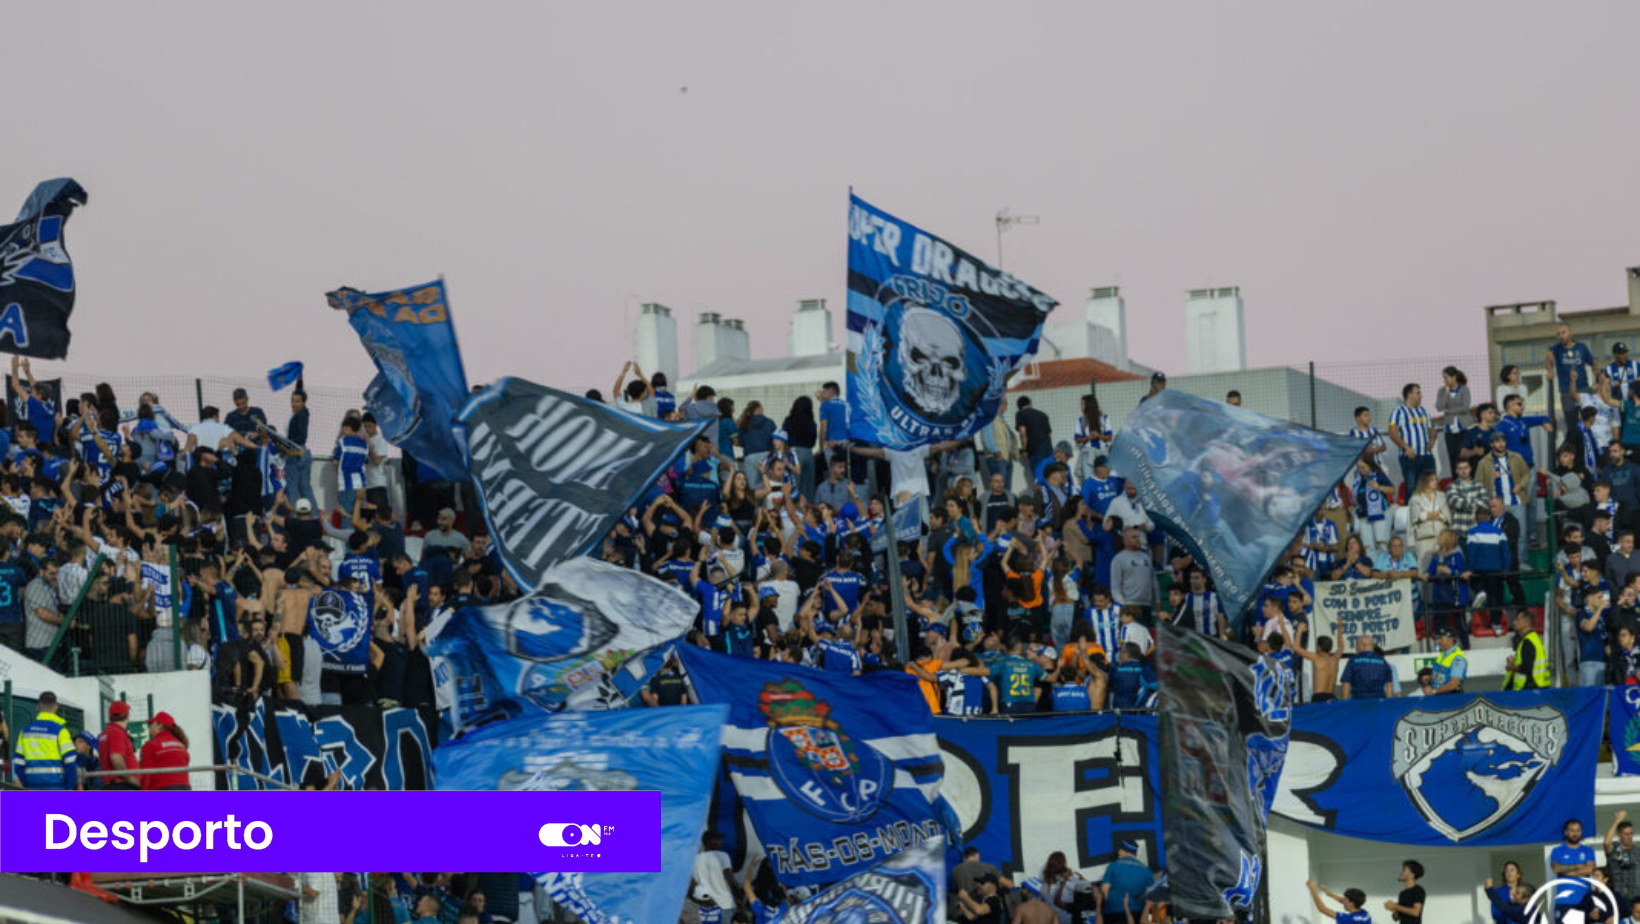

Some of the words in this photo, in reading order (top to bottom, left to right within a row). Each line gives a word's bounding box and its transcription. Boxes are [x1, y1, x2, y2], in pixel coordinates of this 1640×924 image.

[849, 204, 901, 267] UPER
[1364, 589, 1403, 609] PORTO
[1362, 617, 1400, 634] PORTO
[1009, 673, 1031, 697] 25
